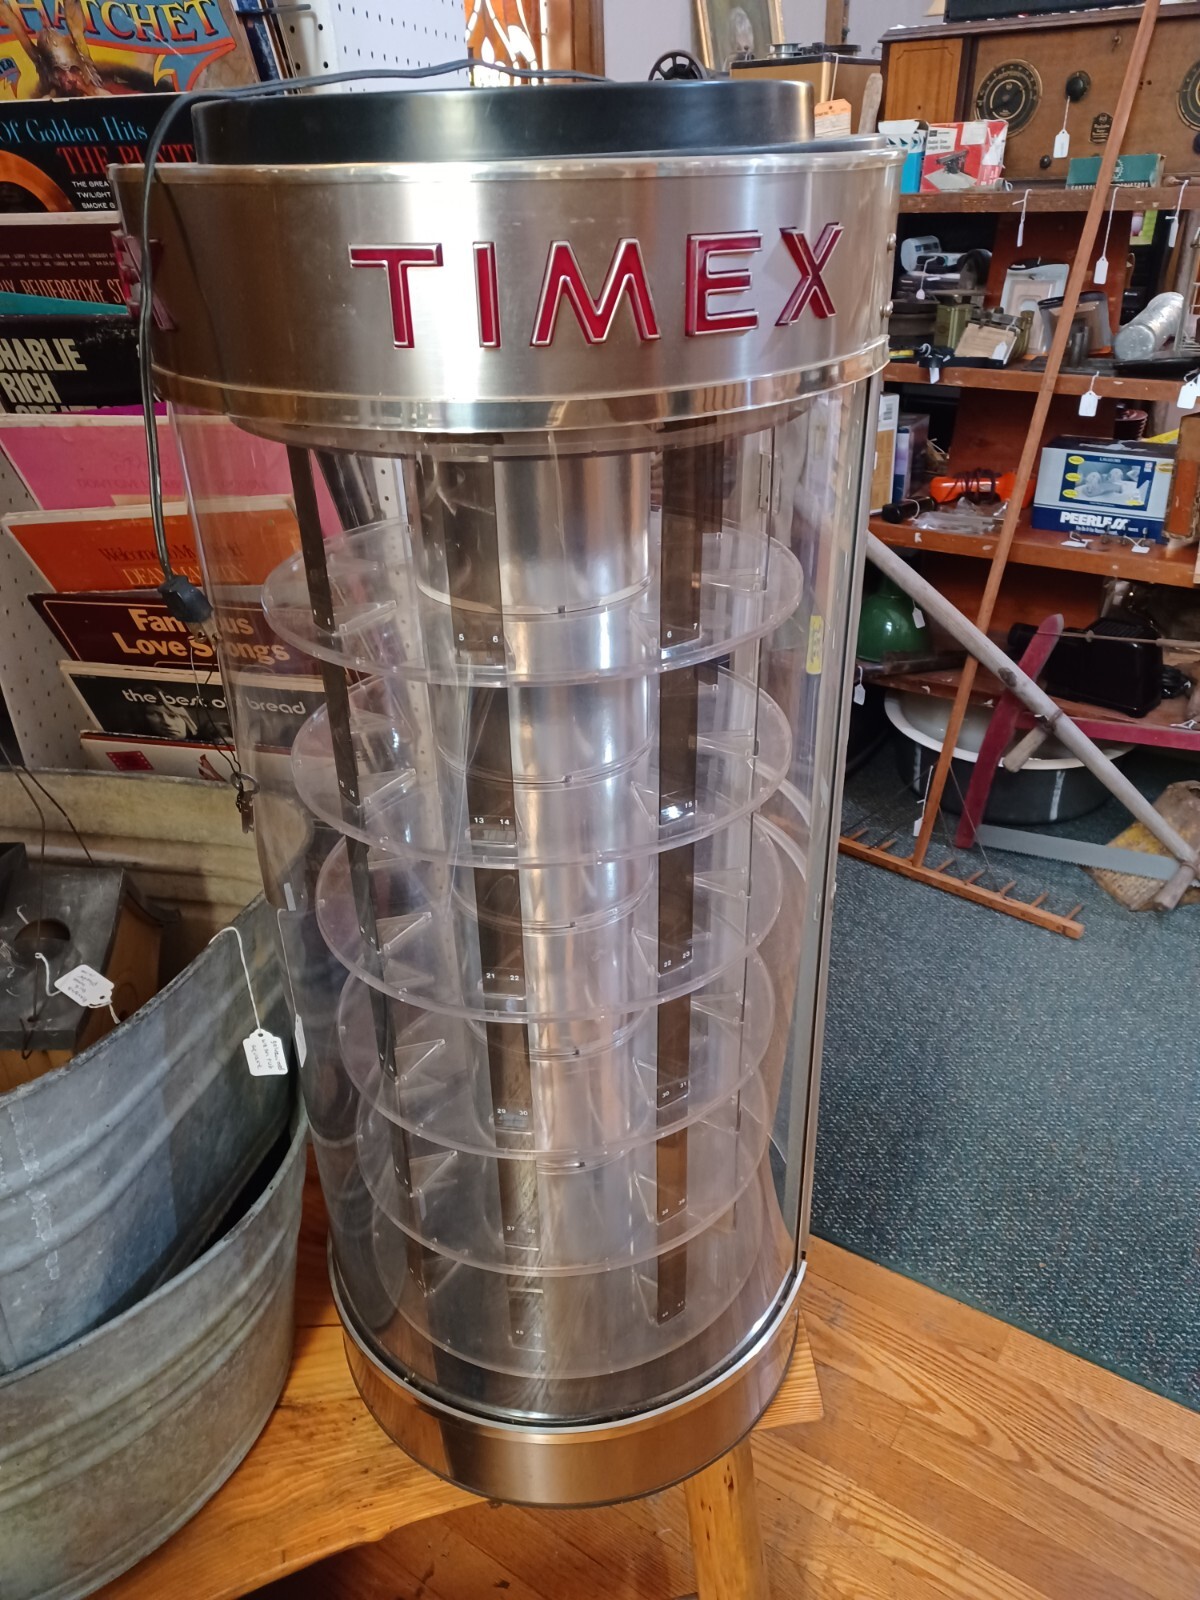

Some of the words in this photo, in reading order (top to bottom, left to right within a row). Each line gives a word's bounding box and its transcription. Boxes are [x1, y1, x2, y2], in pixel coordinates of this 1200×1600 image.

[25, 117, 100, 144] Golden
[101, 115, 149, 142] Hits
[56, 145, 109, 175] THE
[71, 180, 88, 188] THE
[89, 180, 111, 188] GREA
[76, 191, 111, 199] TWILIGHT
[81, 202, 107, 210] SMOKE
[348, 222, 845, 350] TIMEX
[0, 372, 62, 404] RICH
[458, 633, 465, 641] 5
[492, 635, 499, 643] 6
[666, 630, 673, 638] 6
[112, 632, 189, 657] Love
[121, 689, 158, 704] the
[159, 690, 210, 707] best
[244, 697, 307, 716] bread
[684, 801, 693, 809] 15
[473, 816, 485, 824] 13
[499, 818, 510, 826] 14
[663, 960, 672, 968] 22
[682, 951, 691, 959] 23
